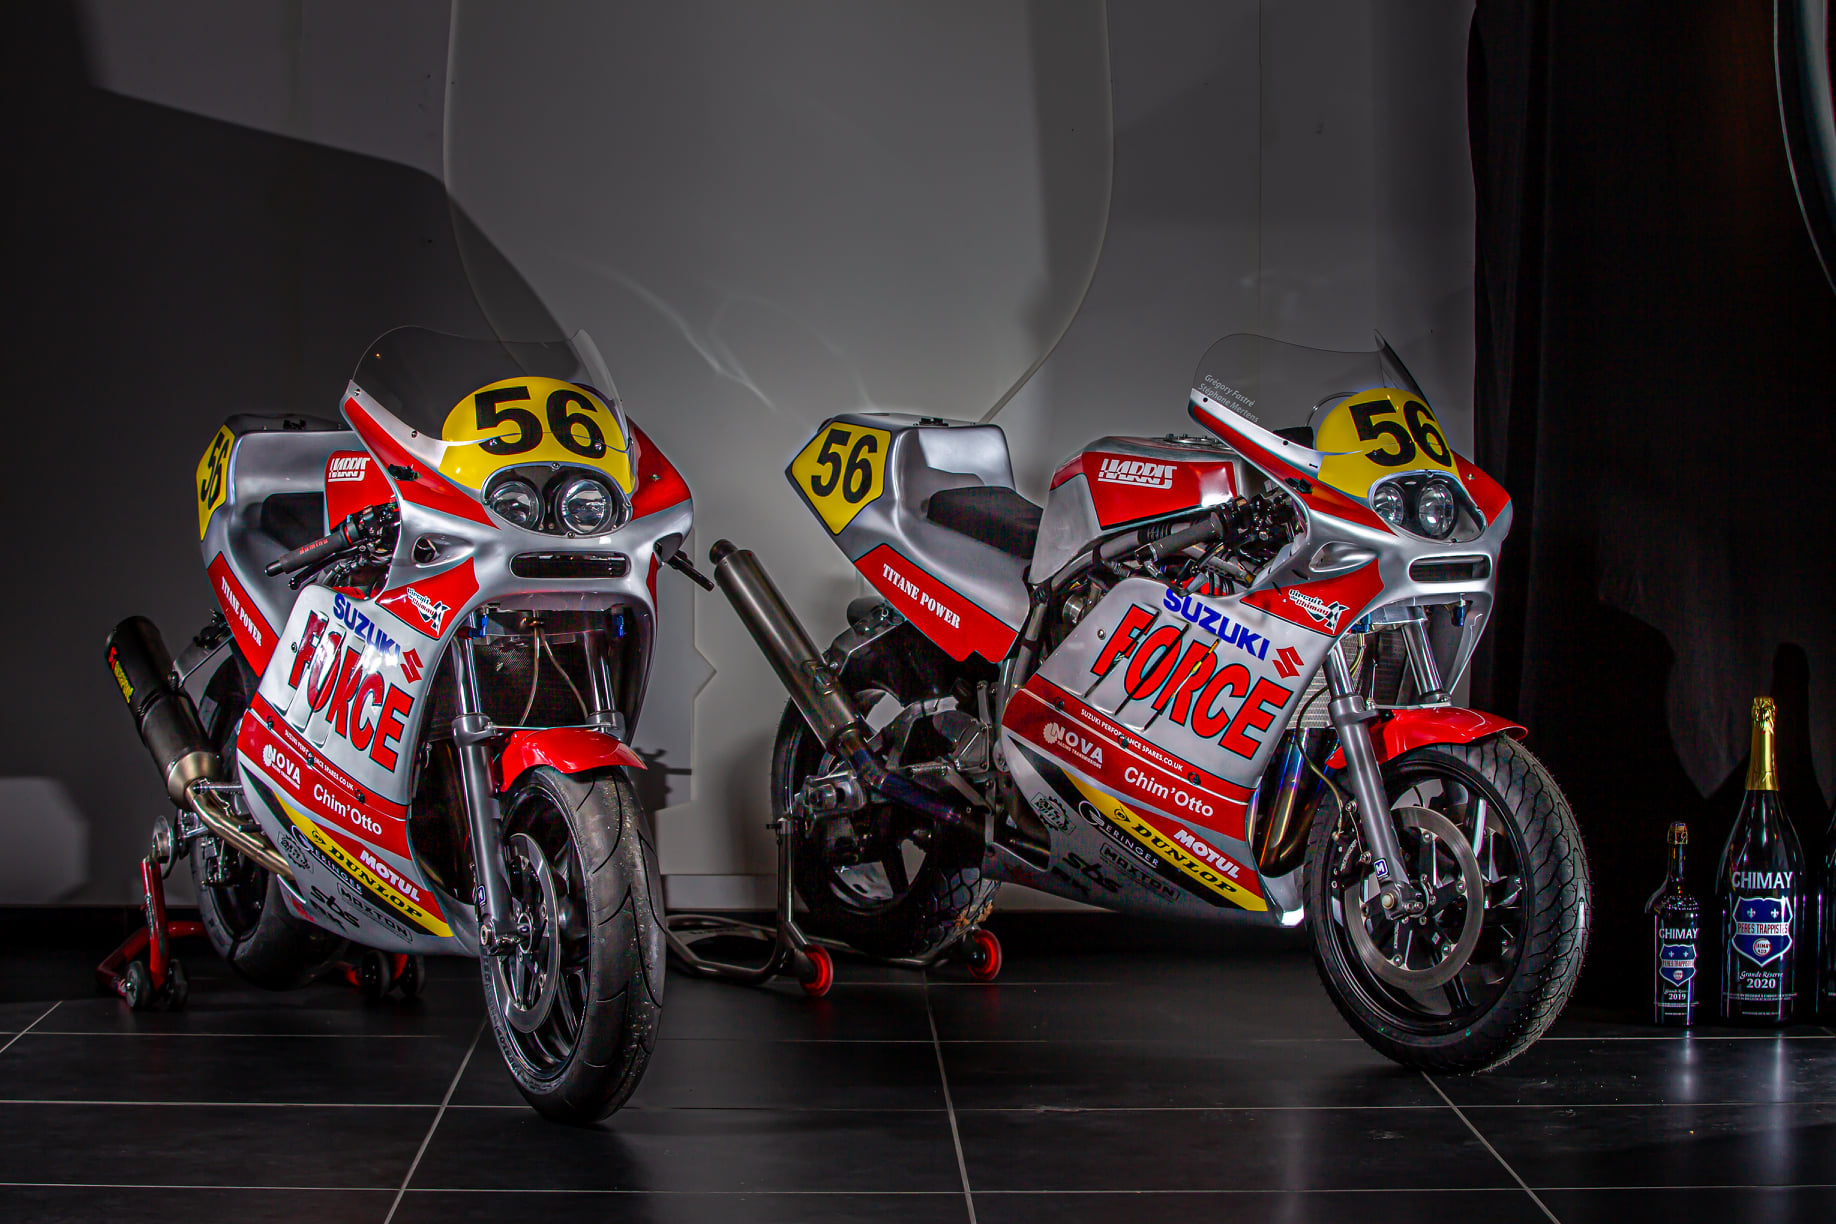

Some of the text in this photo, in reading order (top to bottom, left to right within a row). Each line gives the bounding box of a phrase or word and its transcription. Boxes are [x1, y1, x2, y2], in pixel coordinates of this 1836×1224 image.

[1204, 374, 1232, 395] Grégory
[1230, 401, 1260, 423] Mertens
[475, 386, 607, 459] 56
[1348, 400, 1452, 468] 56
[200, 432, 229, 511] 56
[811, 428, 877, 504] 56
[333, 593, 400, 657] SUZUKI
[882, 564, 961, 629] TITANE POWER
[1163, 588, 1270, 661] SUZUKI
[239, 606, 262, 647] POWER
[288, 610, 415, 773] FORCE
[1090, 604, 1294, 760] FORCE
[265, 744, 300, 784] NOVA
[1048, 722, 1103, 764] NOVA
[1081, 708, 1101, 726] SUZUKI
[1142, 744, 1184, 772] SPARES.CO.UK
[1124, 766, 1214, 818] Chim'Otto
[329, 845, 422, 918] DUNLOP
[360, 850, 420, 902] MOTUL
[1104, 847, 1175, 896] MAXTON
[1132, 823, 1238, 893] DUNLOP
[1173, 829, 1241, 879] MOTUL
[1732, 871, 1793, 889] CHIMAY
[1658, 928, 1699, 940] CHIMAY
[1746, 978, 1776, 989] 2020
